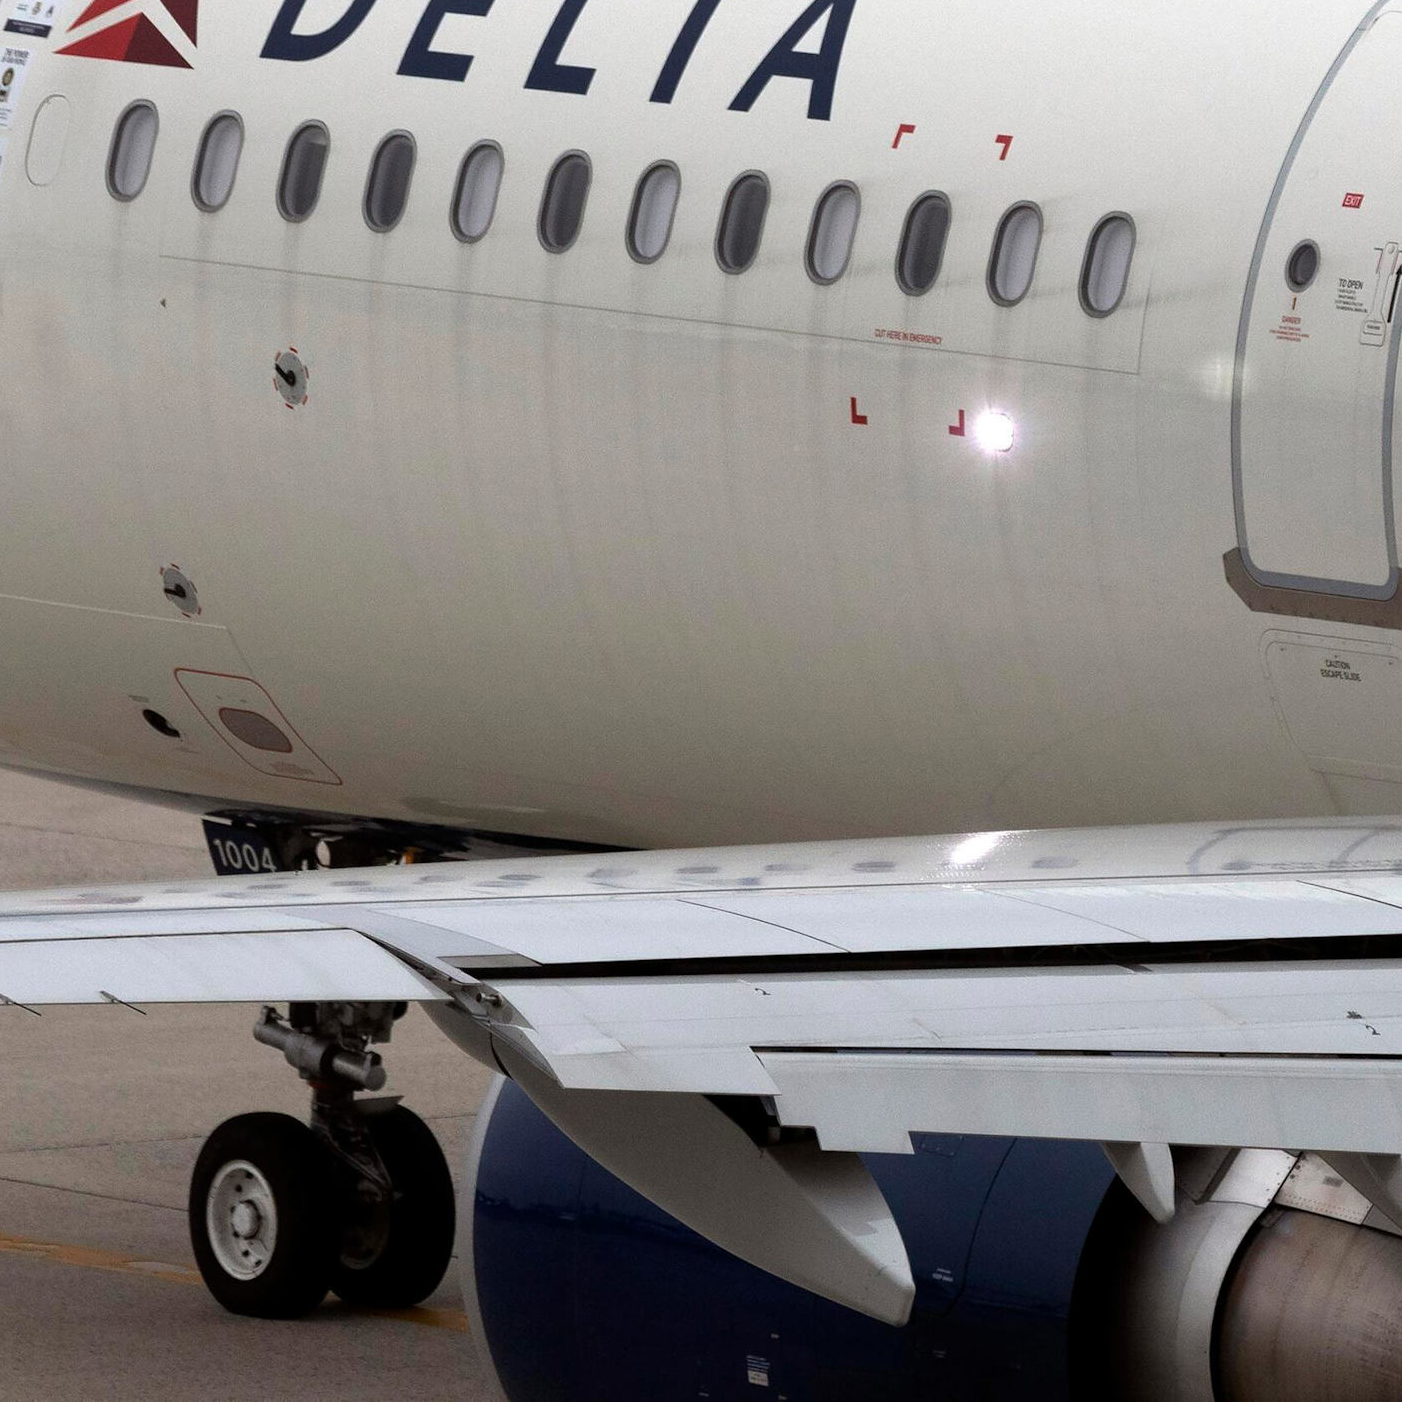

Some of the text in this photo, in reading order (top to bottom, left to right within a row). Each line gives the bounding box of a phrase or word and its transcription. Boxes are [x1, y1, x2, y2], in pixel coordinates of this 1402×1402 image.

[1344, 196, 1361, 207] EXIT
[1338, 278, 1364, 290] TO OPEN
[213, 838, 278, 873] 1004
